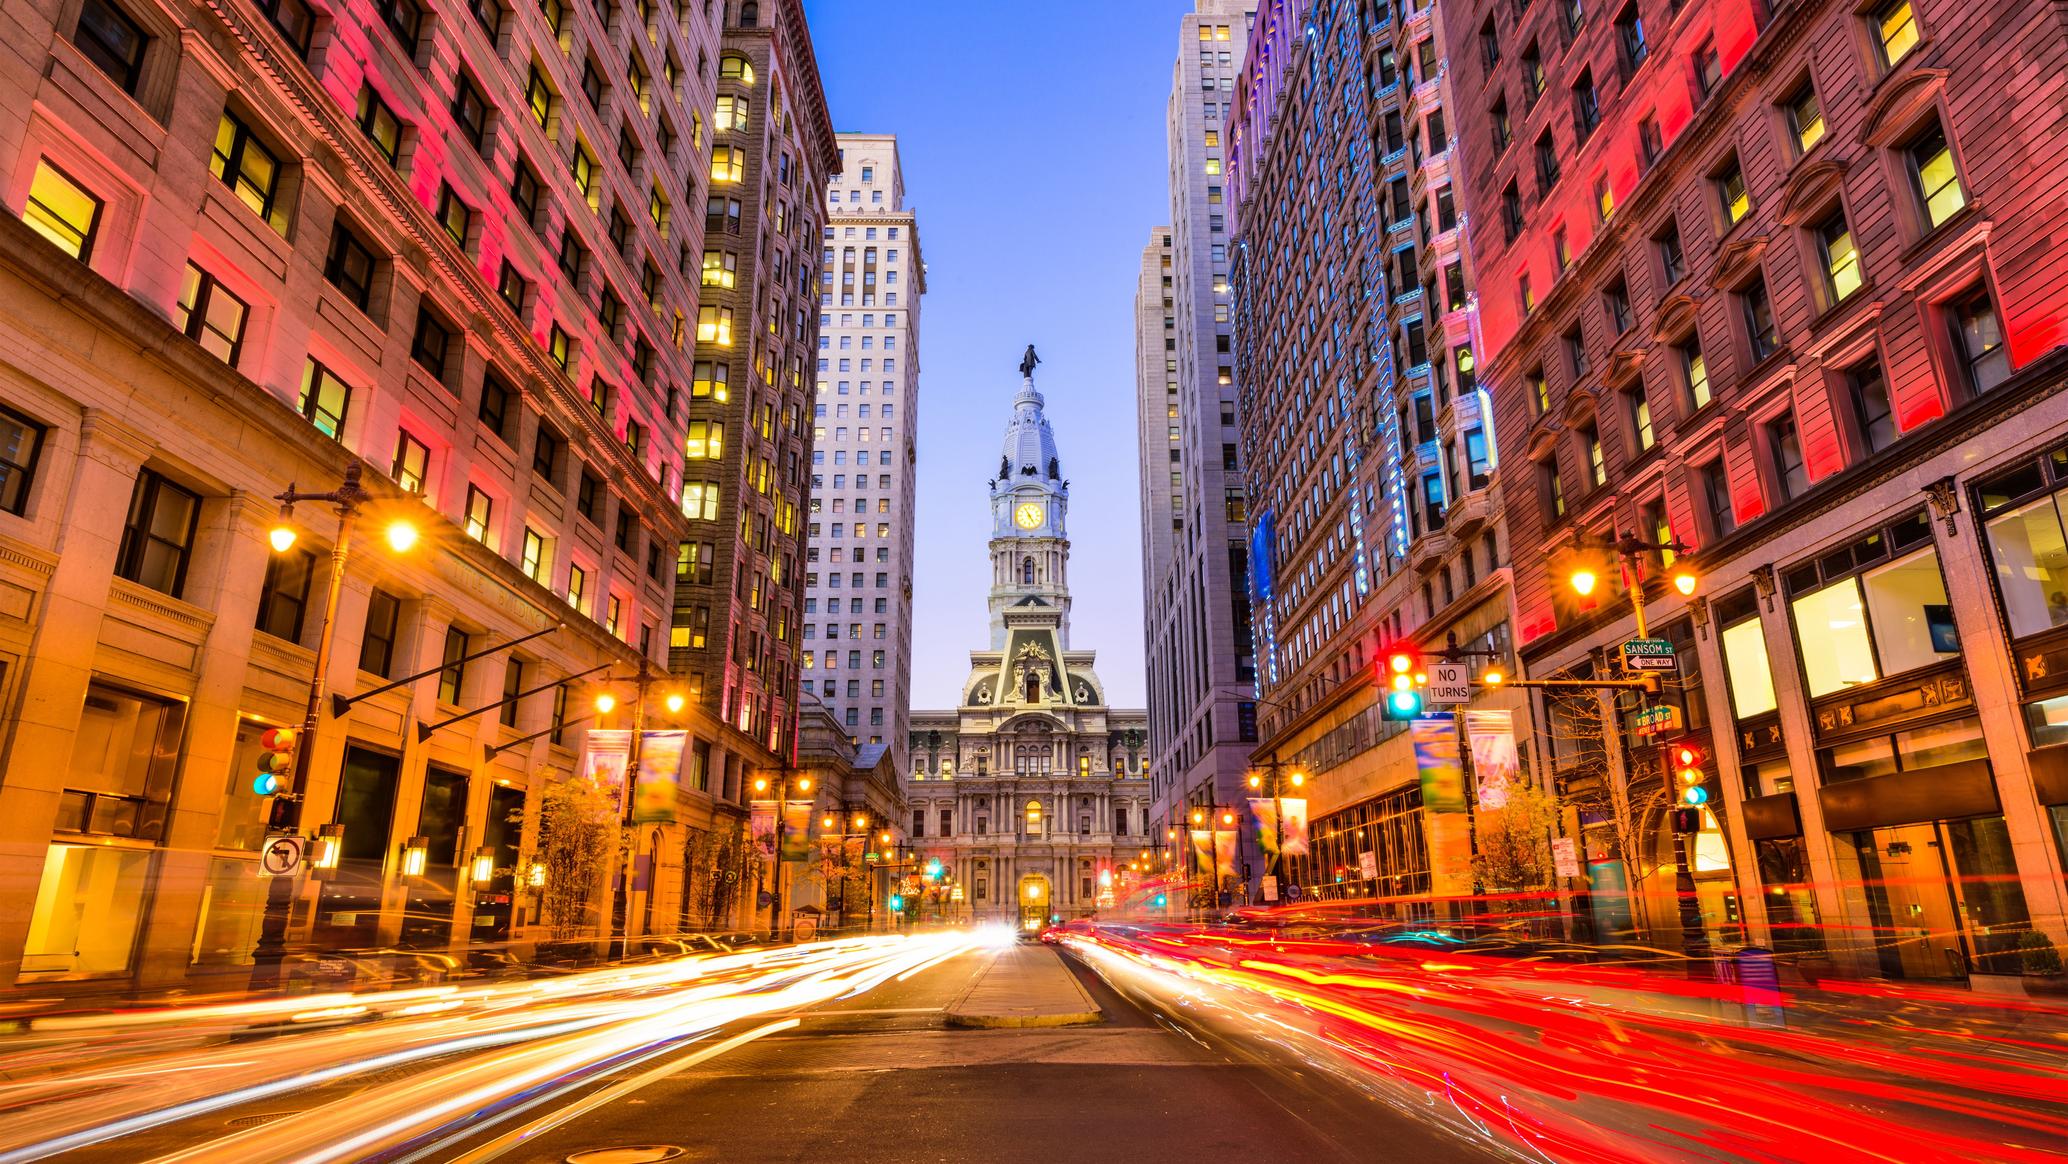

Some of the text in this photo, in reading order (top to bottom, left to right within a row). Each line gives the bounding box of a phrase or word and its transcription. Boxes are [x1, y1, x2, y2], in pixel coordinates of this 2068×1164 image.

[1625, 644, 1662, 654] SANSOM
[1438, 669, 1456, 681] NO
[1431, 687, 1468, 697] TURNS
[1642, 712, 1664, 726] BROAD
